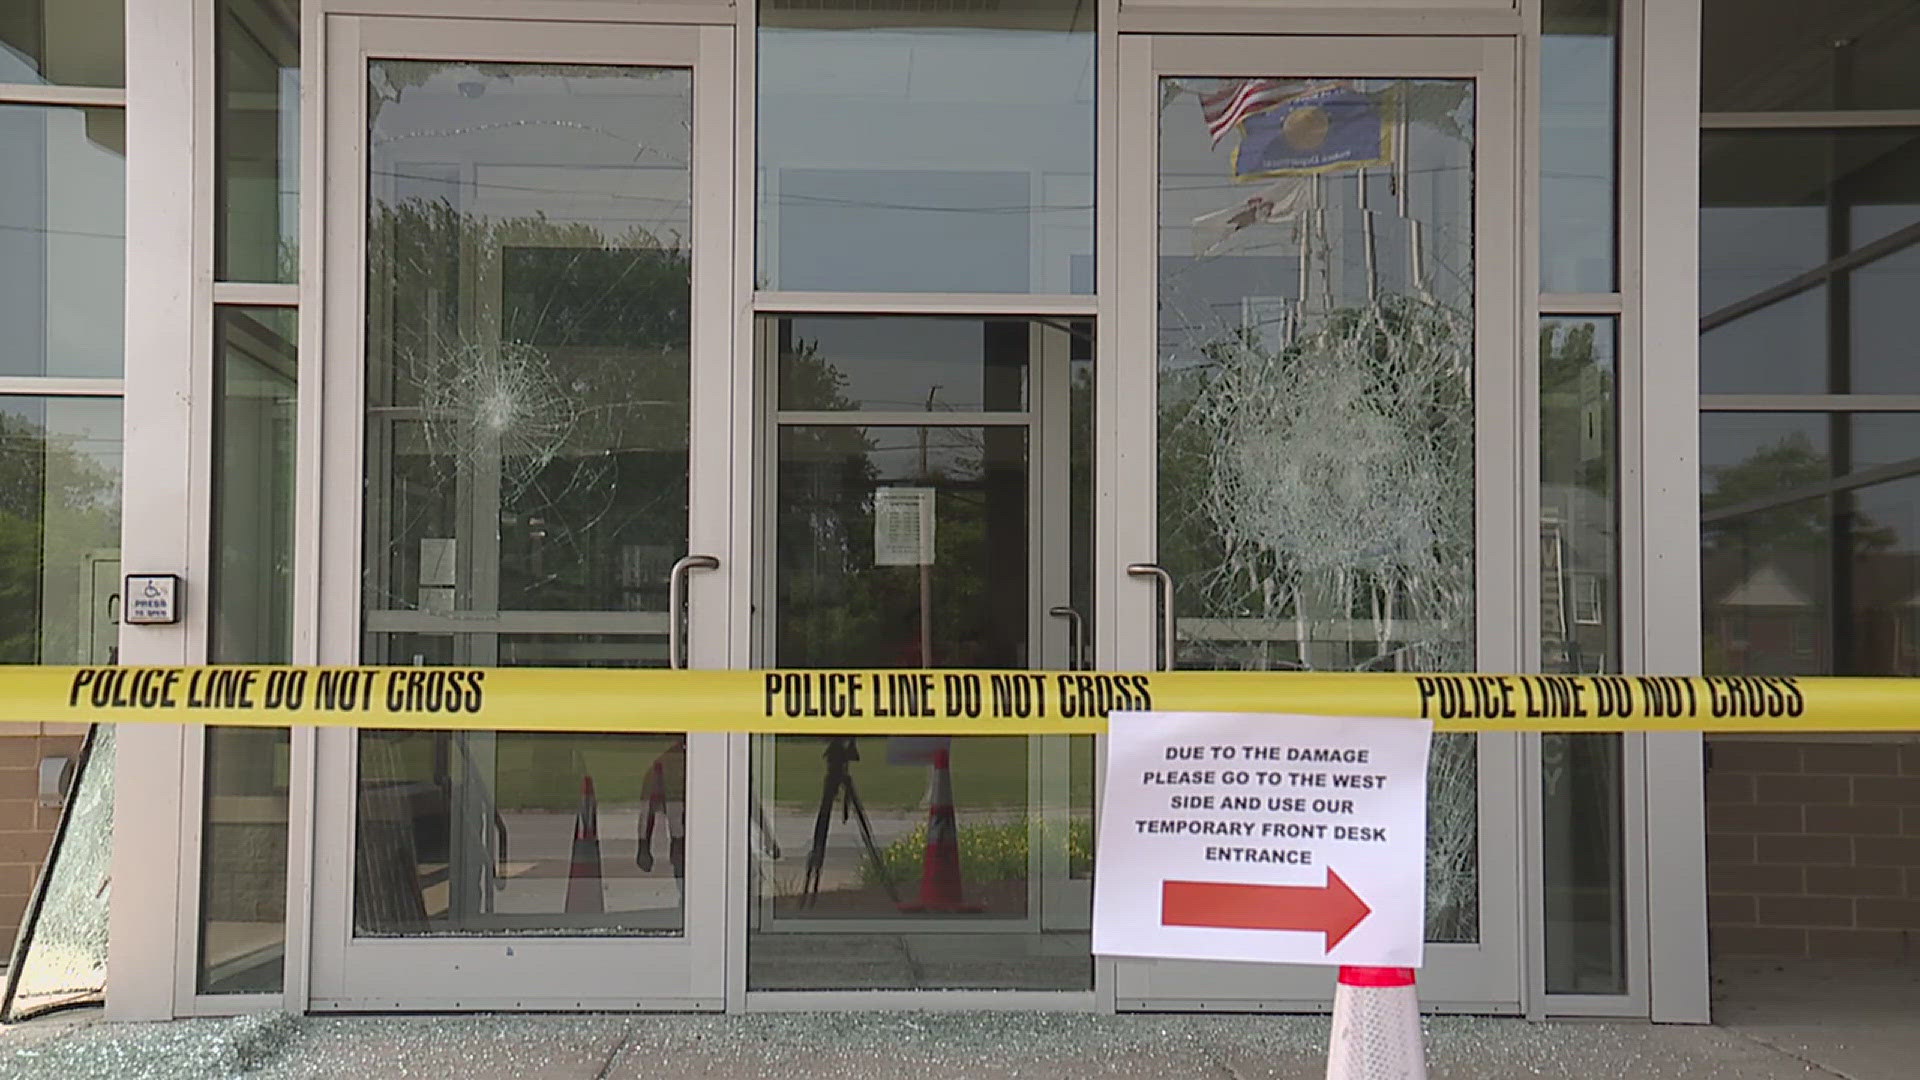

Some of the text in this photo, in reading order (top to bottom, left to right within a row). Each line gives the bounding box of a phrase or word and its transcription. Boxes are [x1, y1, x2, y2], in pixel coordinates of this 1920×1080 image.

[70, 669, 485, 713] POLICE LINE DO NOT CROSS
[765, 673, 1152, 719] POLICE LINE DO NOT CROSS
[1416, 677, 1804, 719] POLICE LINE DO NOT CROSS
[1165, 746, 1369, 764] DUE TO THE DAMAGE
[1143, 771, 1386, 789] PLEASE GO TO THE WEST
[1171, 795, 1353, 814] SIDE AND USE OUR
[1135, 820, 1386, 842] TEMPORARY FRONT DESK
[1206, 846, 1311, 864] ENTRANCE
